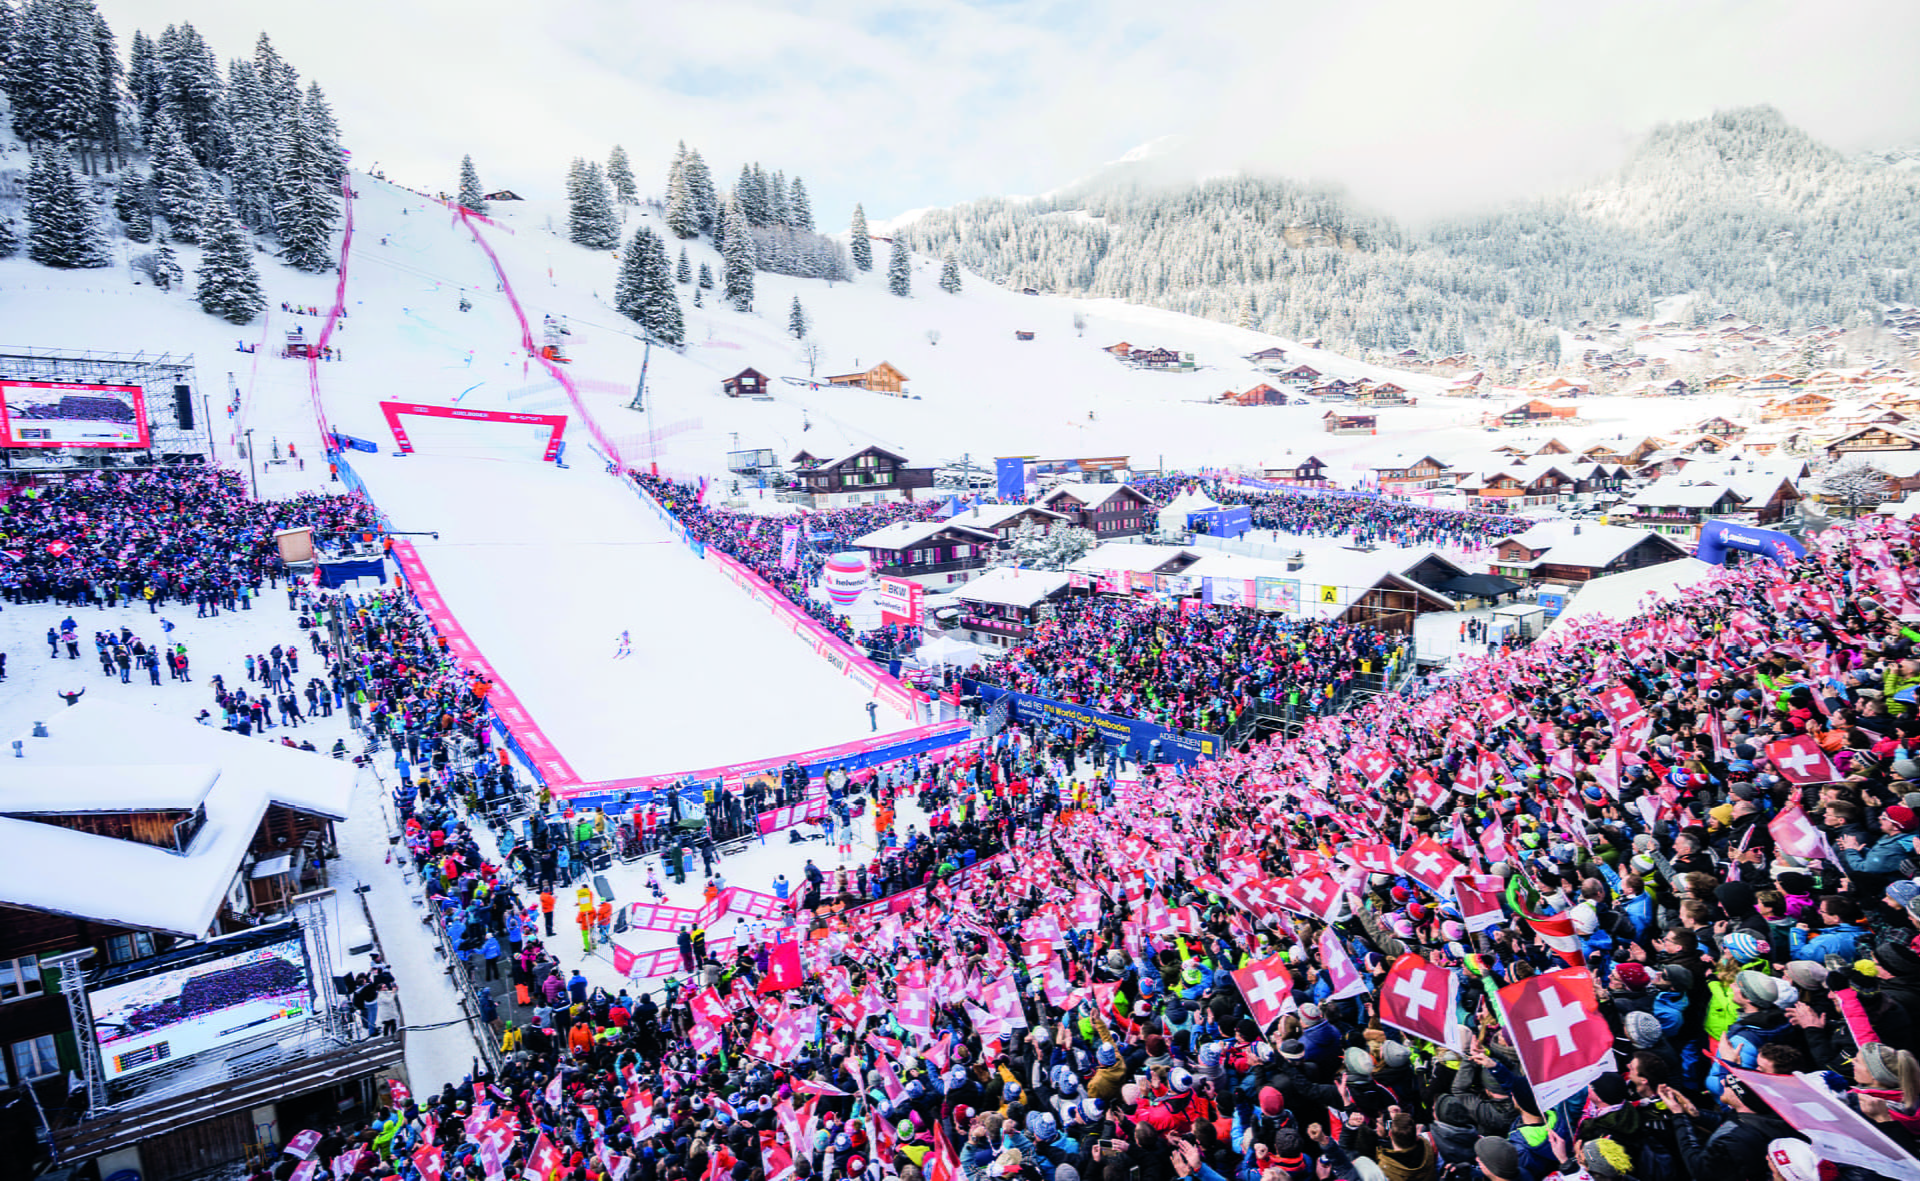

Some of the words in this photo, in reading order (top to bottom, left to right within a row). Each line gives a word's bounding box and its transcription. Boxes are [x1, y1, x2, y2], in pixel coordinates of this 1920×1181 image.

[888, 584, 906, 597] BKW
[1324, 591, 1334, 602] A
[828, 652, 844, 670] BKW
[1018, 698, 1032, 708] Audi
[1055, 707, 1075, 718] World
[1077, 712, 1091, 723] Cup
[1092, 716, 1131, 733] Adelboden
[1160, 732, 1200, 746] ADELBODEN
